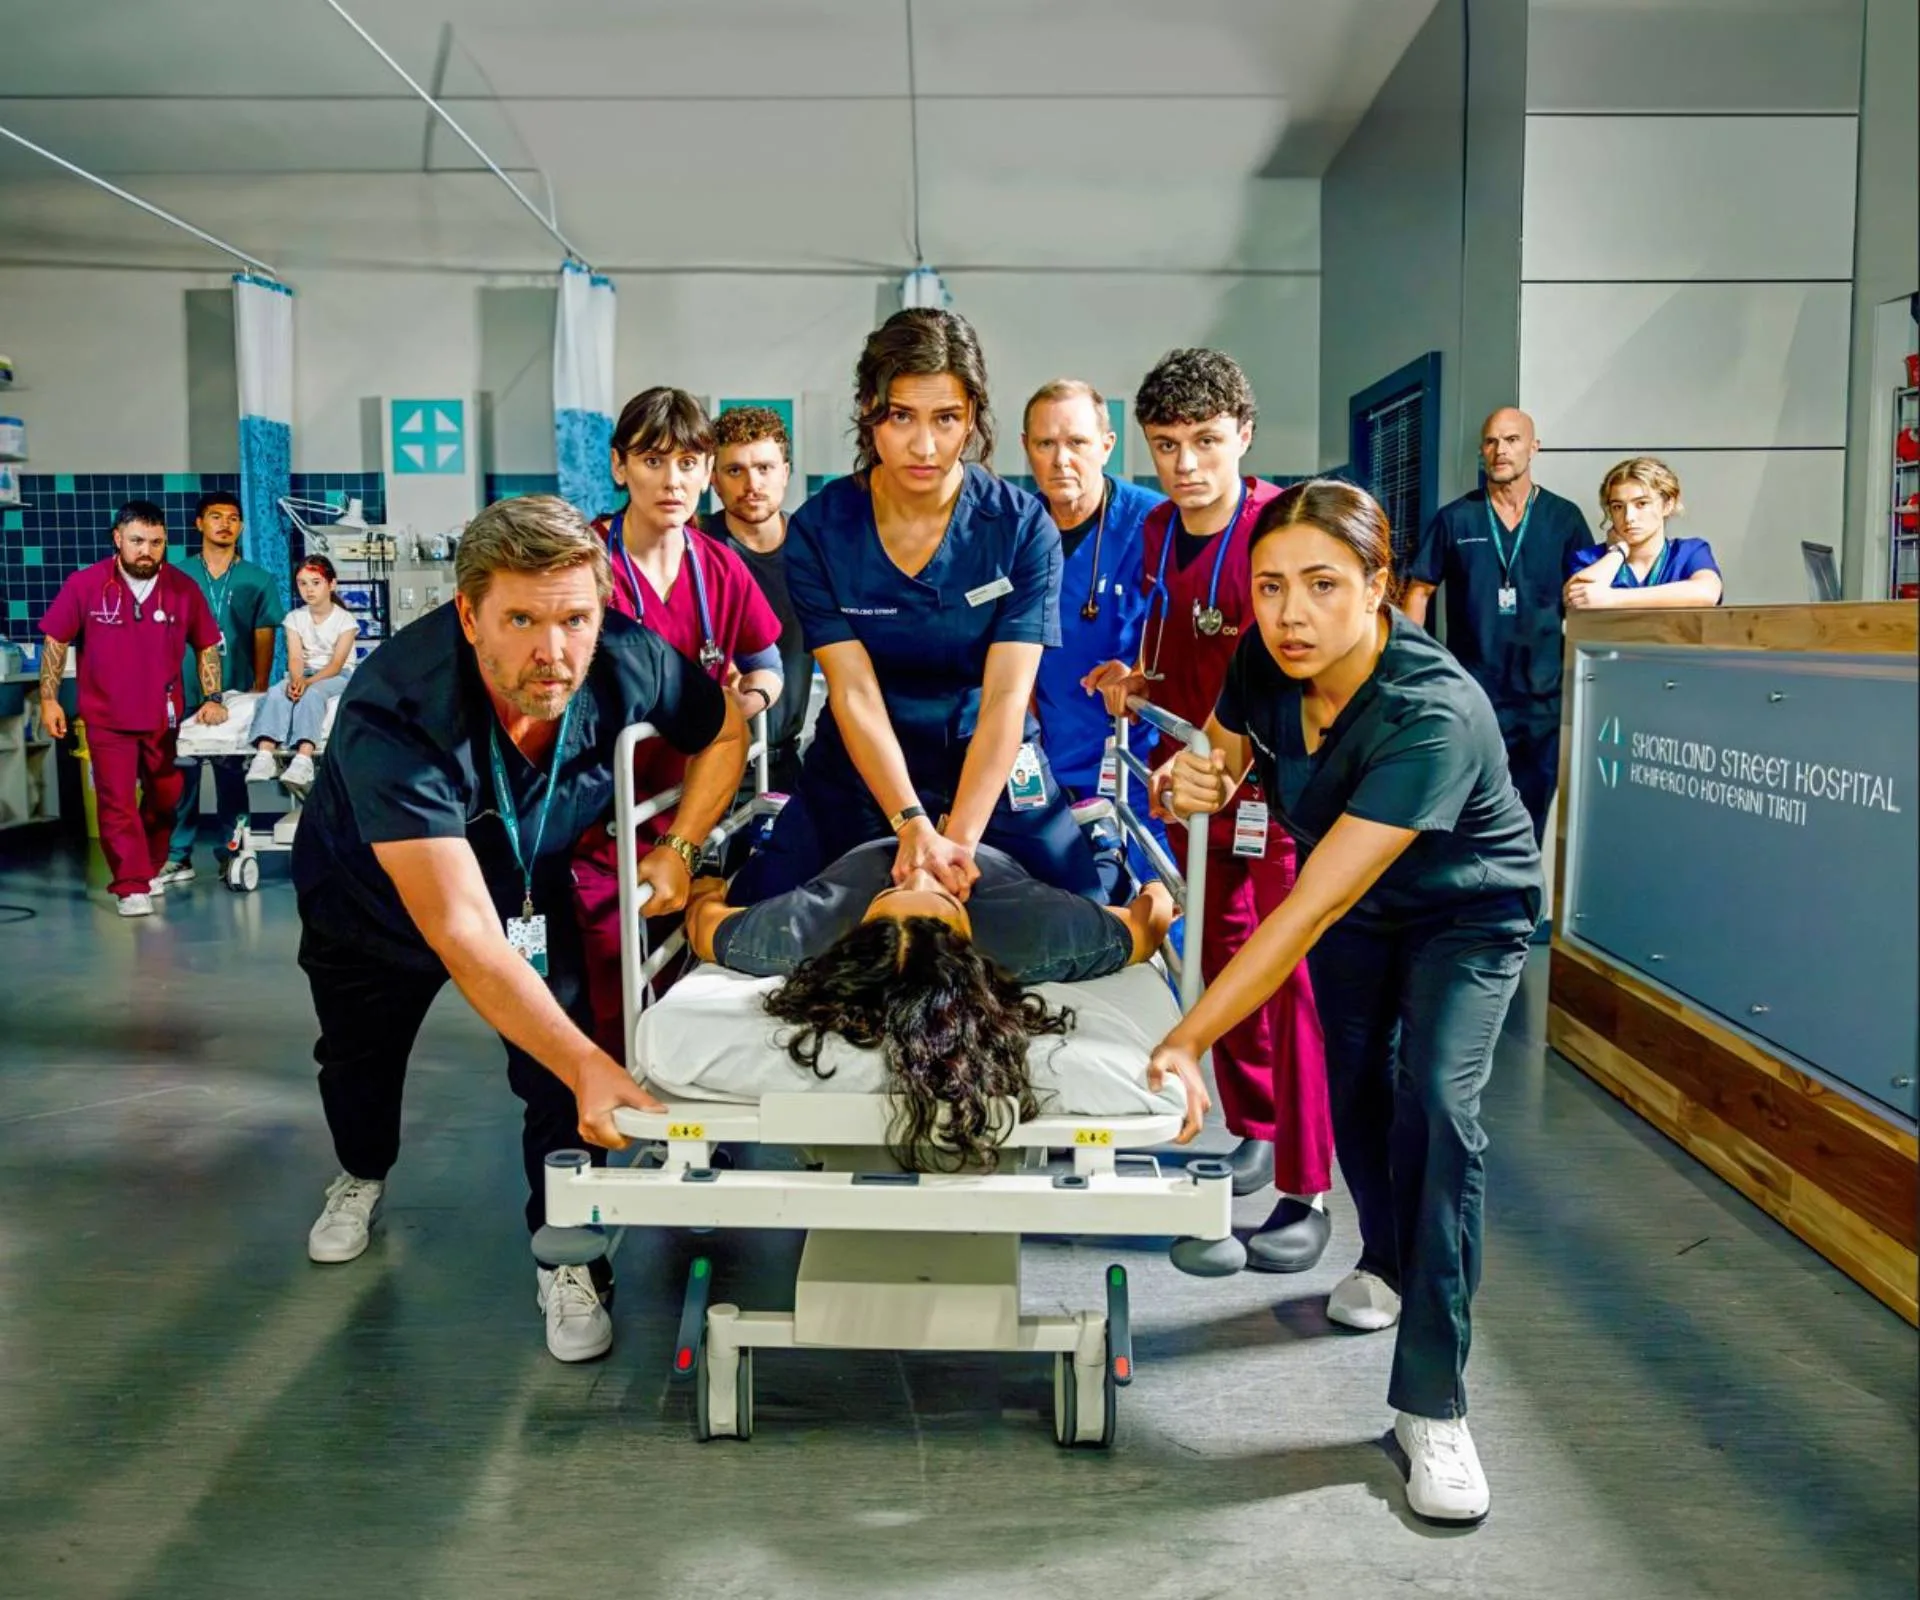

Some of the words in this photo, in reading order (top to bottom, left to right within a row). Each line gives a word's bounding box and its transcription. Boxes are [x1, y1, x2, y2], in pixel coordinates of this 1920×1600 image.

[1687, 776, 1699, 799] O
[1767, 793, 1807, 826] TIRITI
[1794, 760, 1902, 814] HOSPITAL
